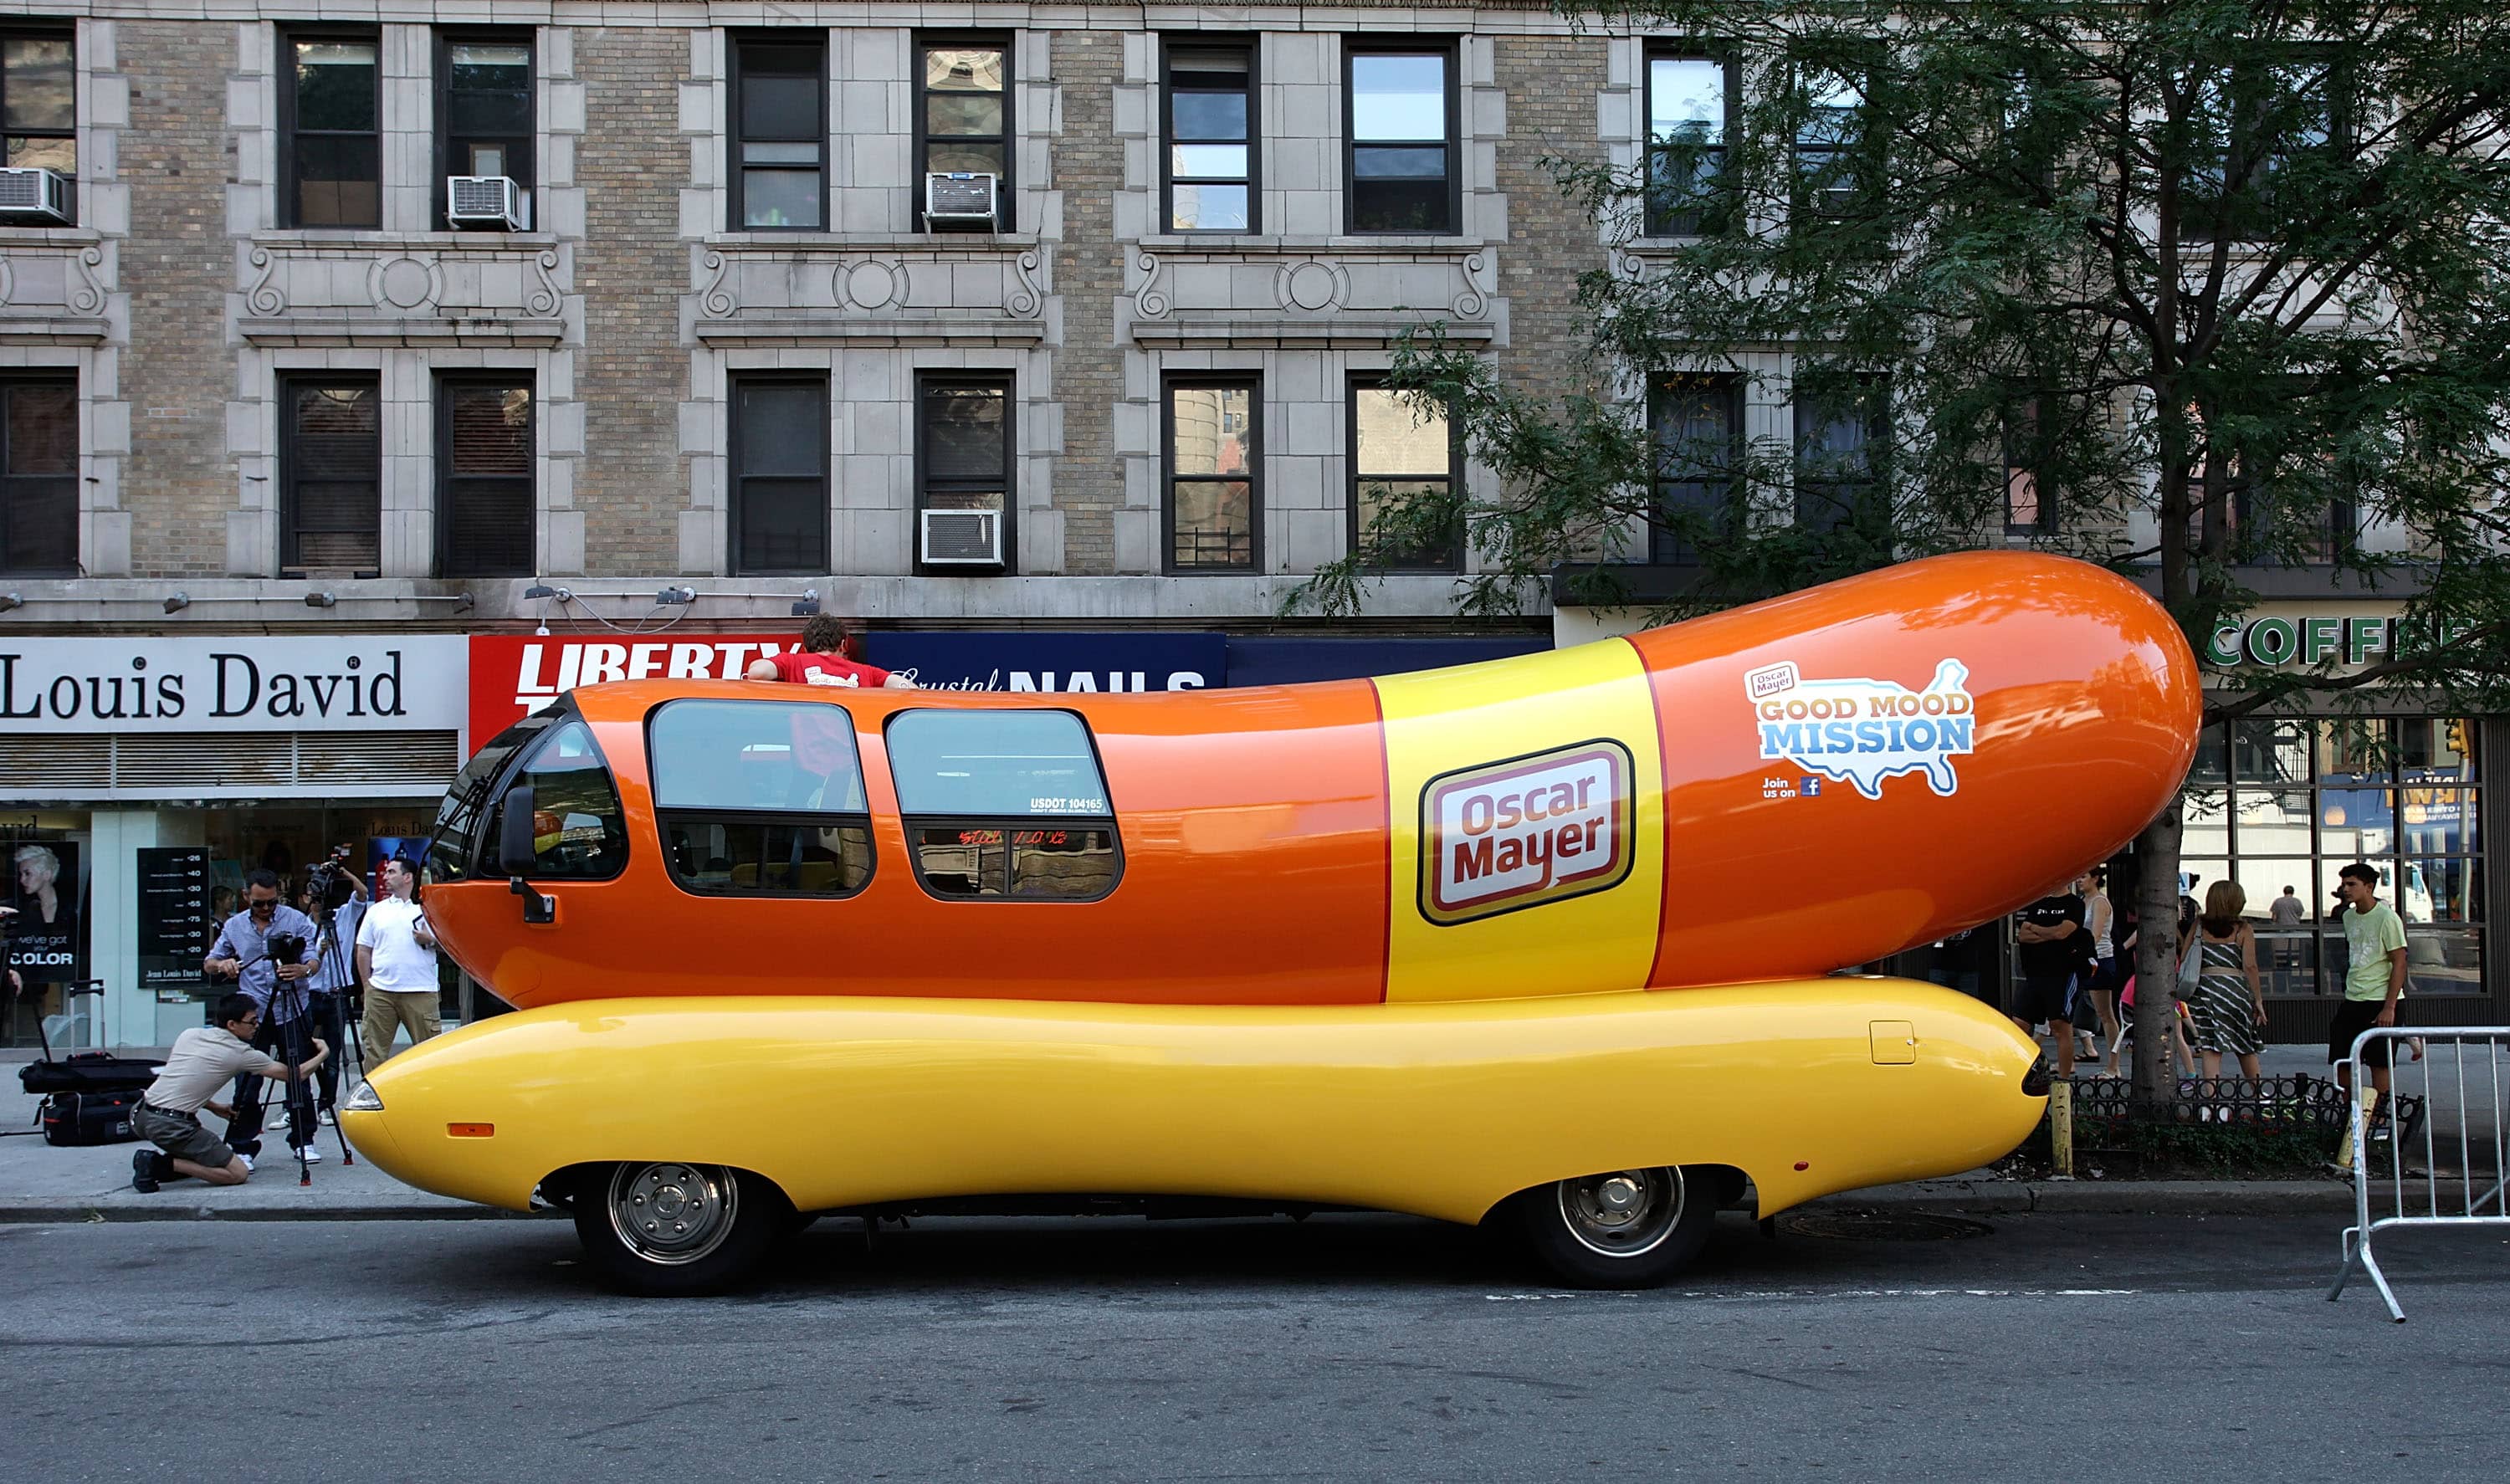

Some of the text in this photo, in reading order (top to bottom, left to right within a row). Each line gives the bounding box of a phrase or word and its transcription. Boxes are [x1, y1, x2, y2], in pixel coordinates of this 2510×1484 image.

[1757, 669, 1786, 683] Oscar
[0, 651, 407, 719] Louis David
[1757, 677, 1790, 693] Mayer
[1760, 693, 1970, 721] GOOD MOOD
[1762, 718, 1971, 755] MISSION
[1763, 777, 1789, 789] Join
[1763, 789, 1777, 798] us
[1780, 789, 1795, 798] on
[1030, 797, 1103, 809] USDOT 104165
[1462, 775, 1596, 836] Oscar
[412, 822, 434, 835] Dav
[1454, 816, 1604, 884] Mayer
[49, 935, 68, 947] got
